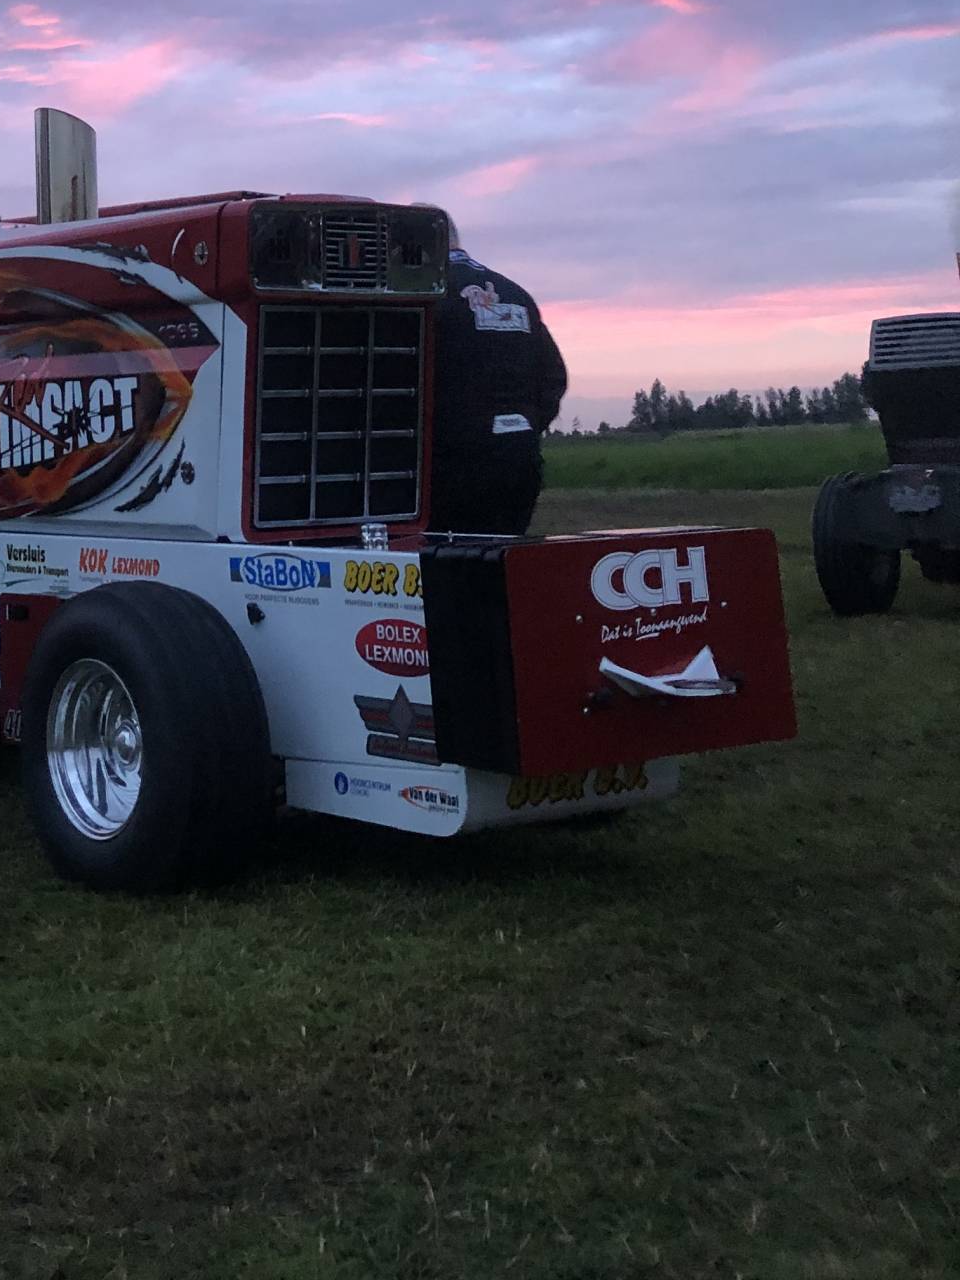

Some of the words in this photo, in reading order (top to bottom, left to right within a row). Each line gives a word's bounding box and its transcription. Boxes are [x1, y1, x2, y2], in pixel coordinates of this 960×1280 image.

[6, 544, 46, 563] Versluis
[79, 547, 109, 576] KOK
[112, 556, 161, 577] LEXMOND
[244, 556, 319, 588] StaBoN
[344, 560, 399, 595] BOER
[591, 546, 710, 610] CCH
[376, 624, 421, 643] BOLEX
[601, 624, 621, 643] Dat
[365, 644, 430, 667] LEXMON
[409, 787, 423, 801] Van
[425, 790, 437, 803] der
[439, 792, 459, 808] Waal
